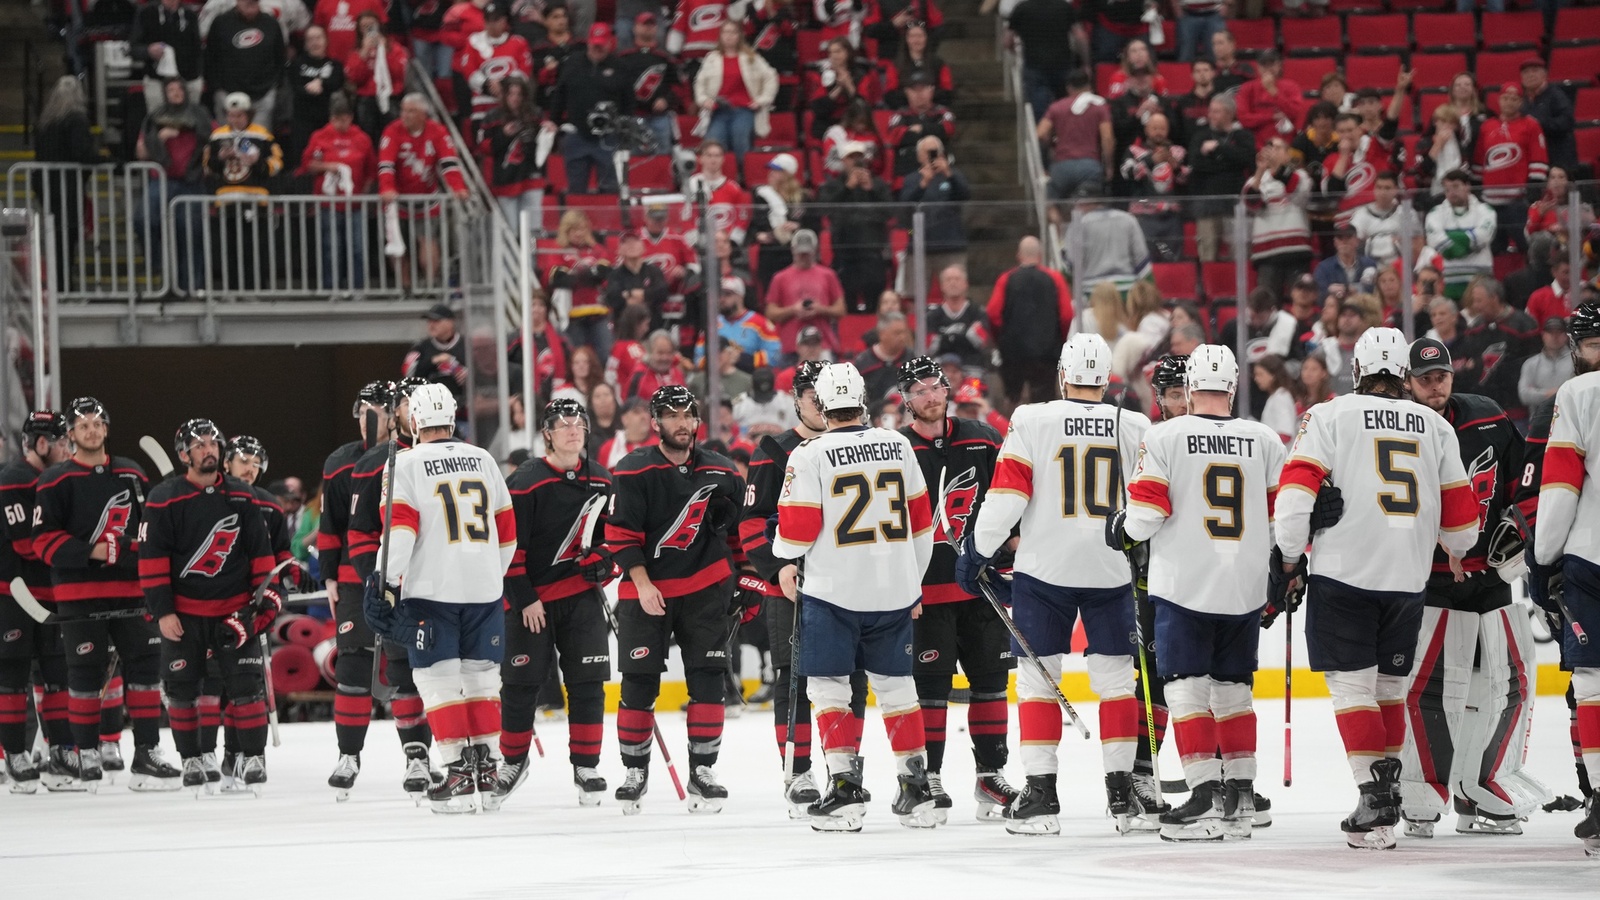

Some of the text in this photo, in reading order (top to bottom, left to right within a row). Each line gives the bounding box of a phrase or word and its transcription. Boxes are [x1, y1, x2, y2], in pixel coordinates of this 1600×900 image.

[1086, 359, 1096, 369] 10
[1211, 362, 1219, 372] 9
[1381, 350, 1389, 361] 5
[835, 385, 848, 395] 23
[433, 402, 443, 411] 13
[1064, 417, 1114, 438] GREER
[1363, 409, 1426, 434] EKBLAD
[825, 441, 903, 468] VERHAEGHE
[1187, 434, 1255, 458] BENNETT
[424, 456, 482, 477] REINHART
[1373, 437, 1421, 517] 5
[1521, 463, 1535, 487] 8
[1053, 443, 1122, 519] 10
[434, 478, 491, 545] 13
[830, 468, 909, 548] 23
[1202, 462, 1245, 541] 9
[4, 502, 26, 526] 50
